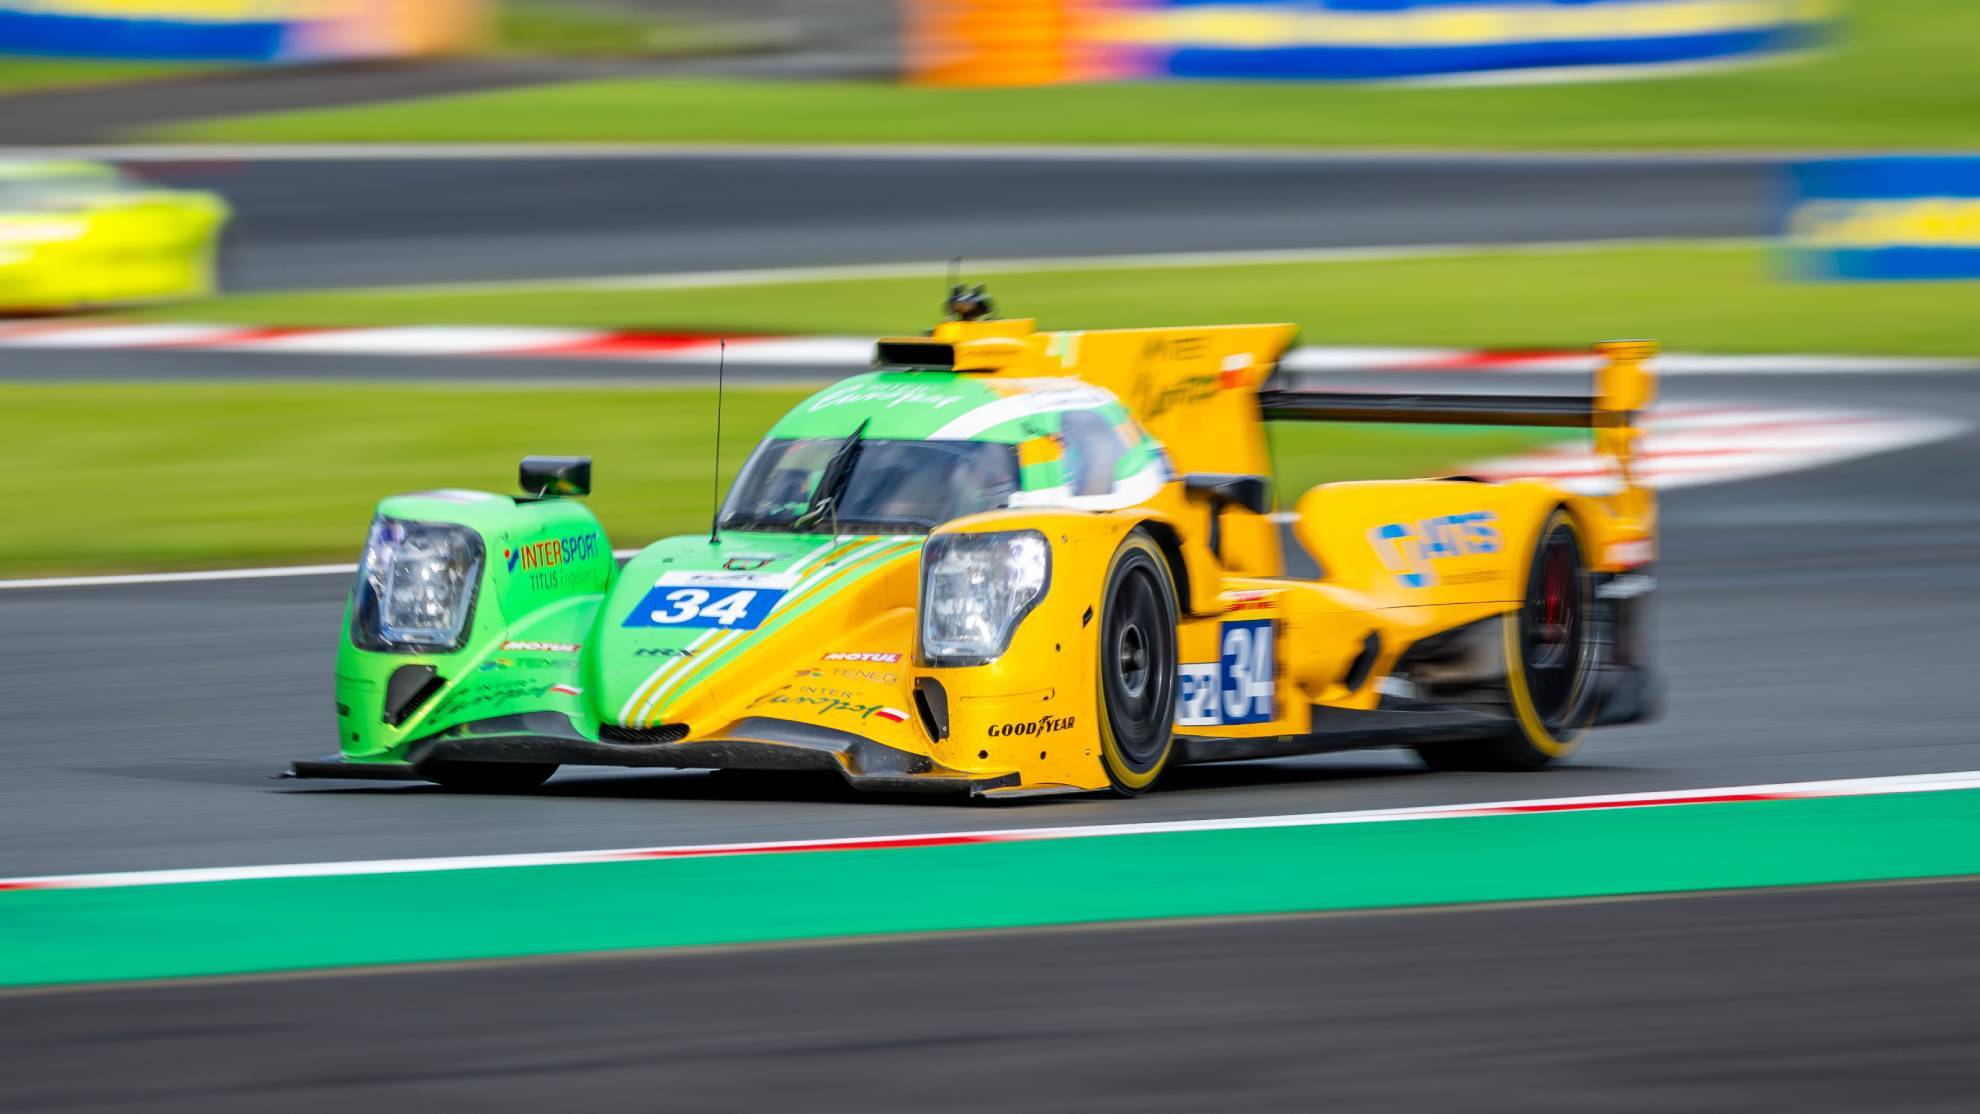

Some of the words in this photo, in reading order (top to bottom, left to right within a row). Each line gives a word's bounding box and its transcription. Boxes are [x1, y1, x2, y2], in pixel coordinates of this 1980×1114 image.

[521, 533, 598, 570] INTERSPORT
[530, 571, 558, 592] TITLIS
[651, 589, 757, 625] 34
[823, 653, 898, 663] MOTUL
[1222, 627, 1275, 718] 34
[800, 686, 854, 698] INTER
[988, 715, 1075, 737] GOODYEAR
